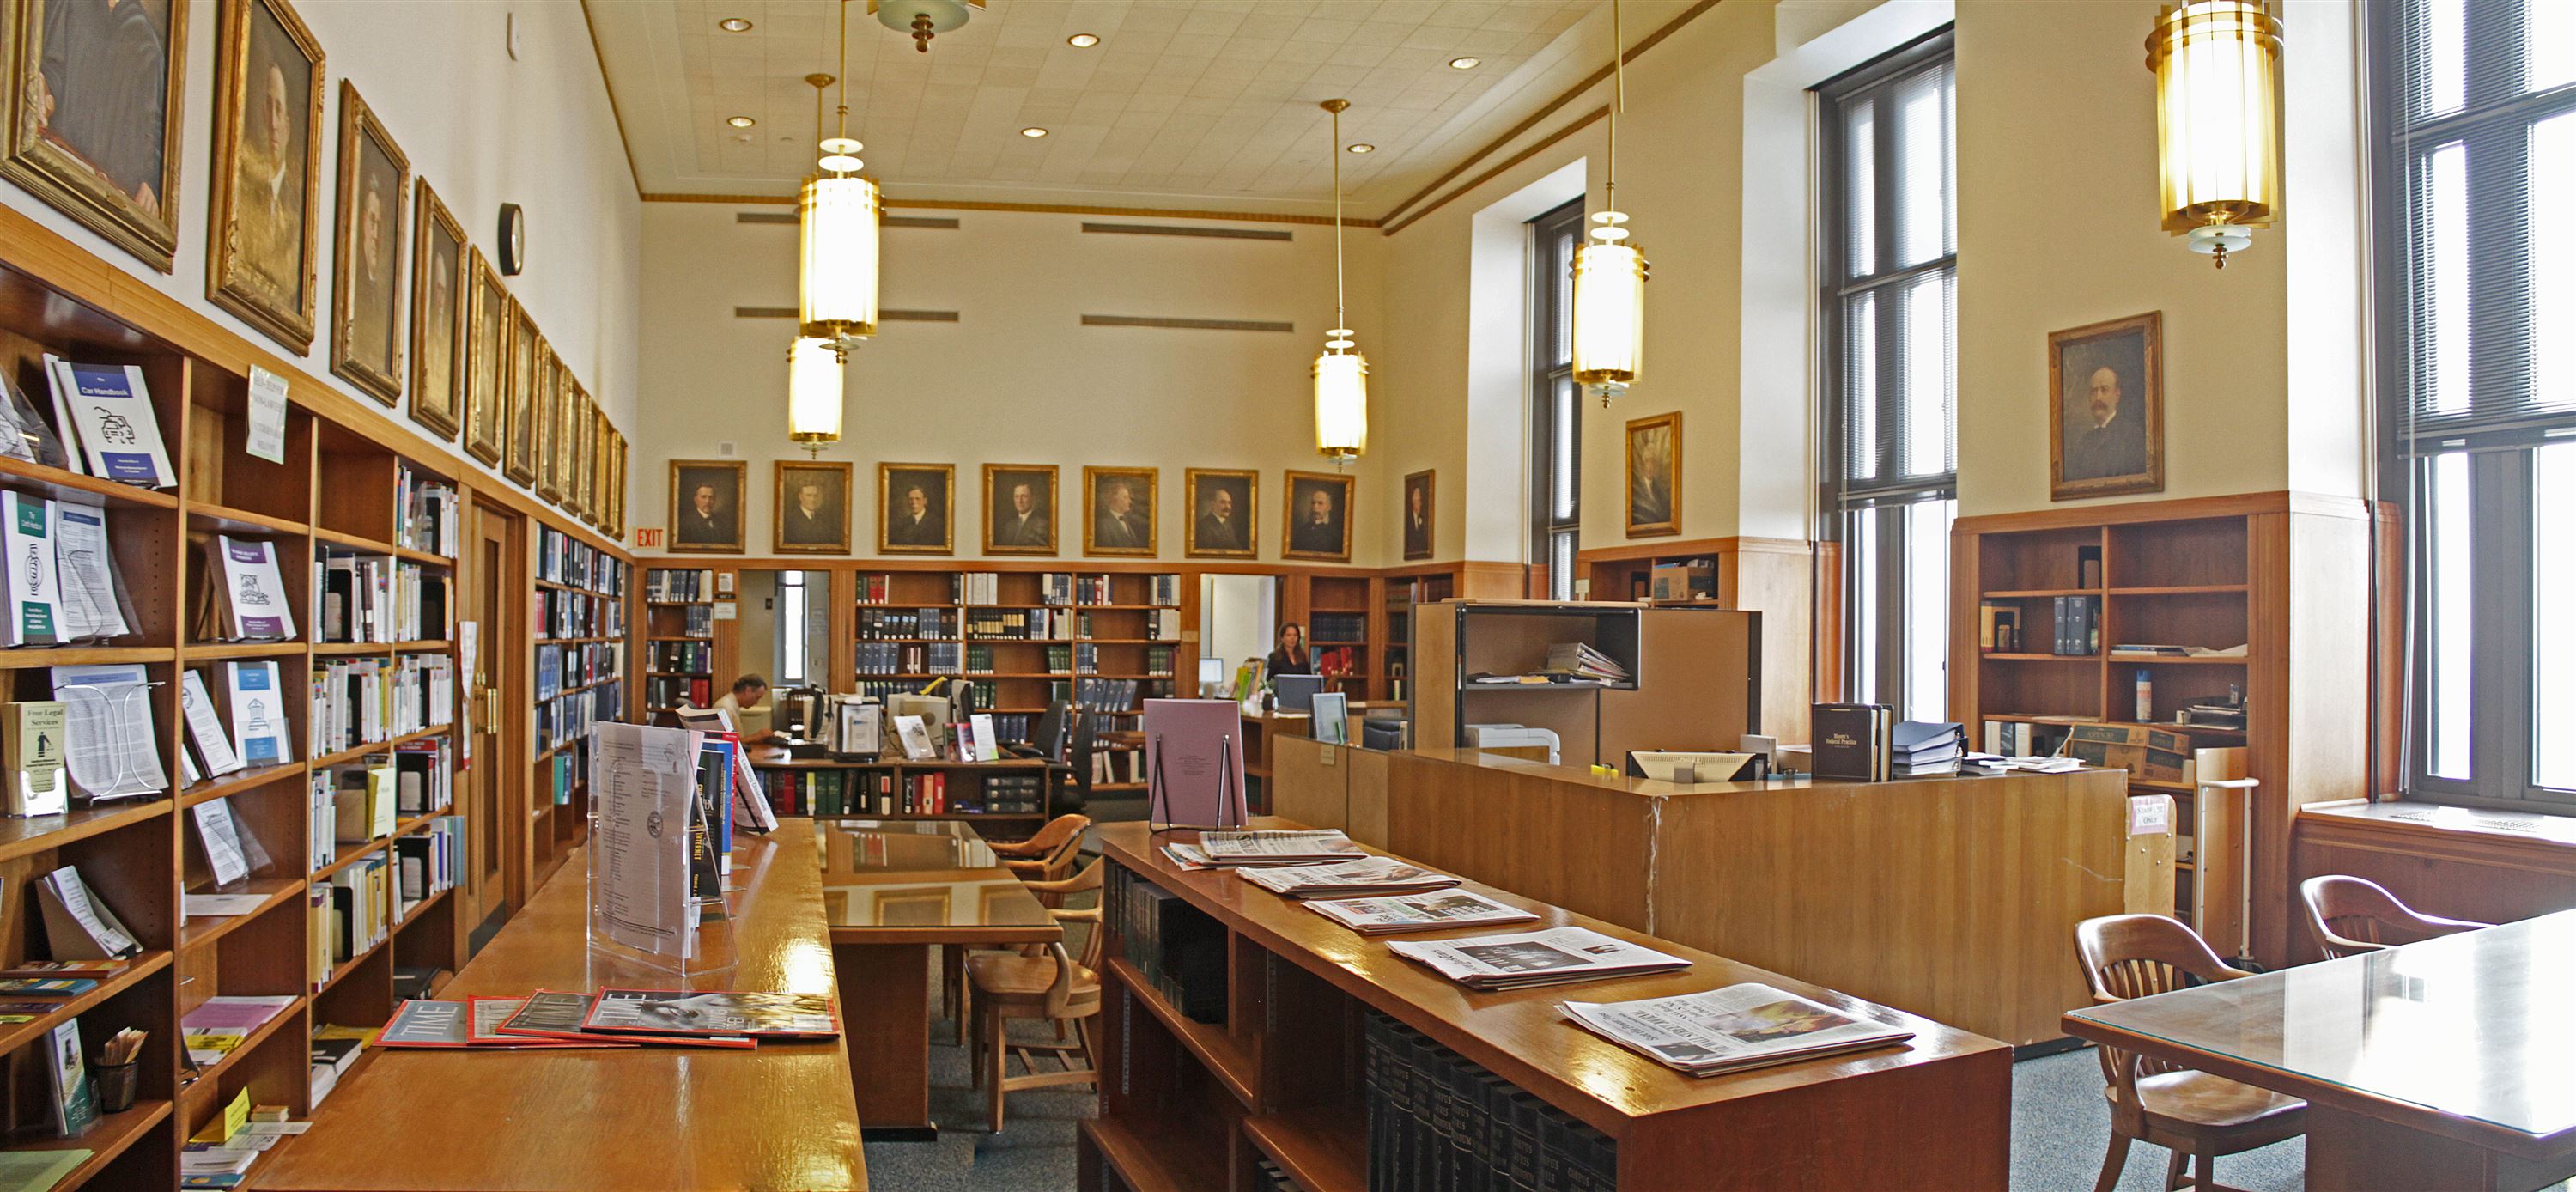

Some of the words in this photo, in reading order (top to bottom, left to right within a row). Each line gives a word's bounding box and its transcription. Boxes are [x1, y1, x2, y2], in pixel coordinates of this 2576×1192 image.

[637, 529, 663, 547] EXIT
[44, 709, 64, 717] Legal
[741, 758, 753, 782] Learning
[694, 832, 702, 861] INTERNET
[598, 994, 647, 1020] TIME
[400, 1007, 459, 1036] TIME
[1662, 1022, 1692, 1037] STREET
[1689, 1036, 1716, 1047] WALL
